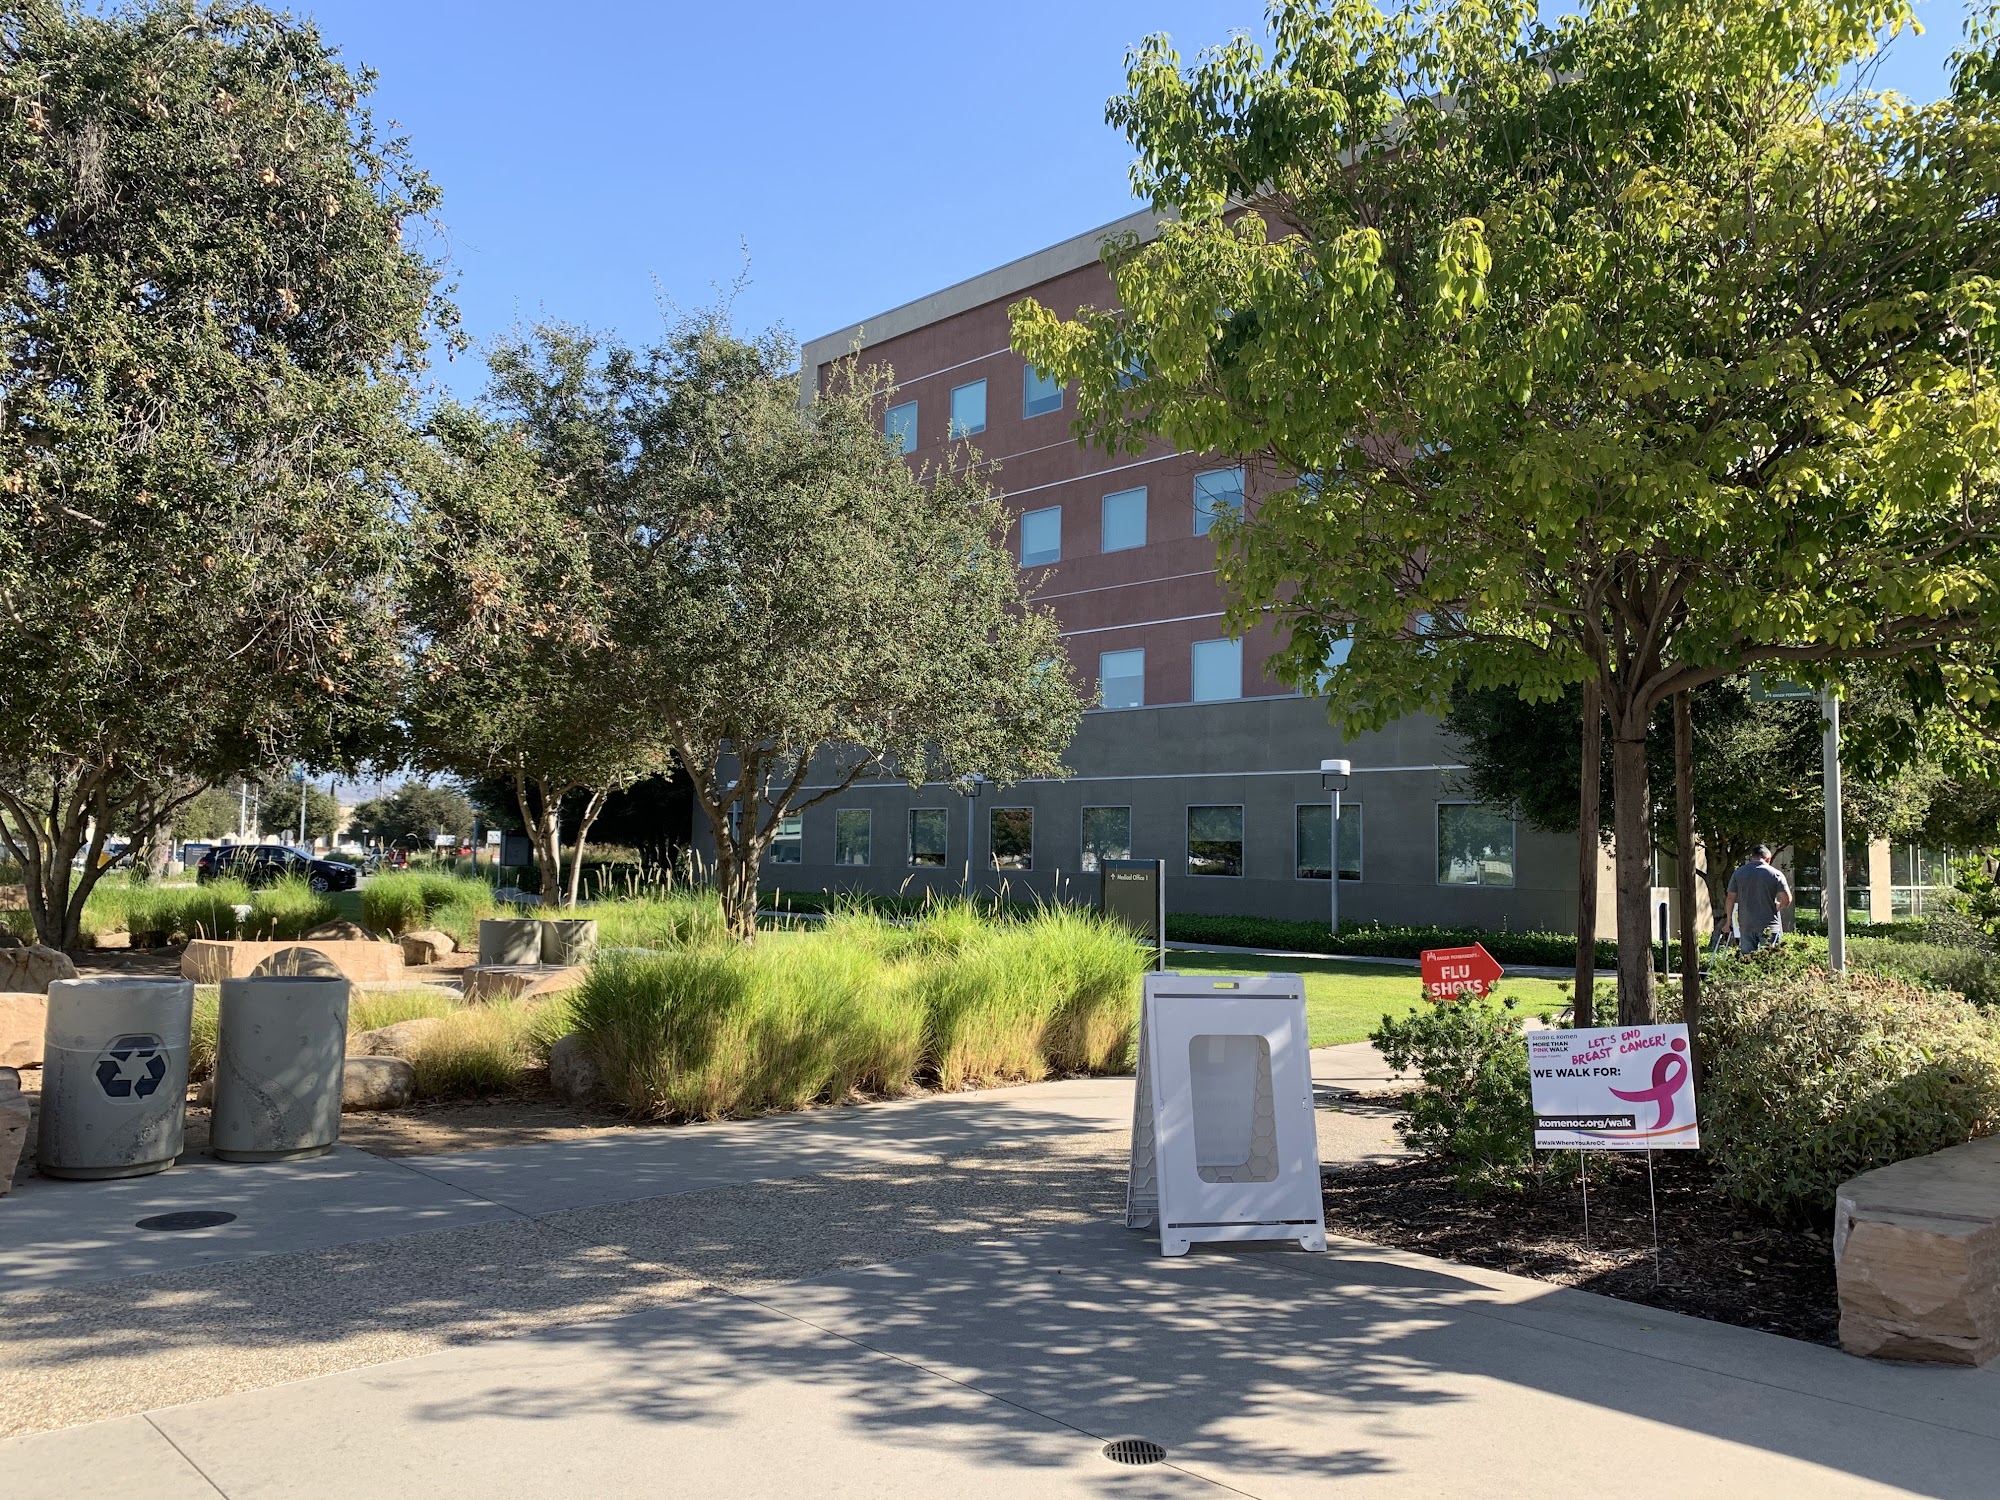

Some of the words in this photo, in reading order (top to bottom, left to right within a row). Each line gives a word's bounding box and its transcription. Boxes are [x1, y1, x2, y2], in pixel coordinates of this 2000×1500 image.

[1441, 965, 1470, 979] FLU
[1431, 980, 1483, 996] SHOTS
[1588, 1034, 1617, 1049] LET'S
[1621, 1029, 1641, 1041] END
[1571, 1046, 1613, 1066] BREAST
[1619, 1033, 1667, 1054] CANCER!
[1533, 1069, 1553, 1078] WE
[1555, 1068, 1590, 1078] WALK
[1593, 1067, 1621, 1077] FOR:
[1538, 1117, 1632, 1129] komenoc.org/walk
